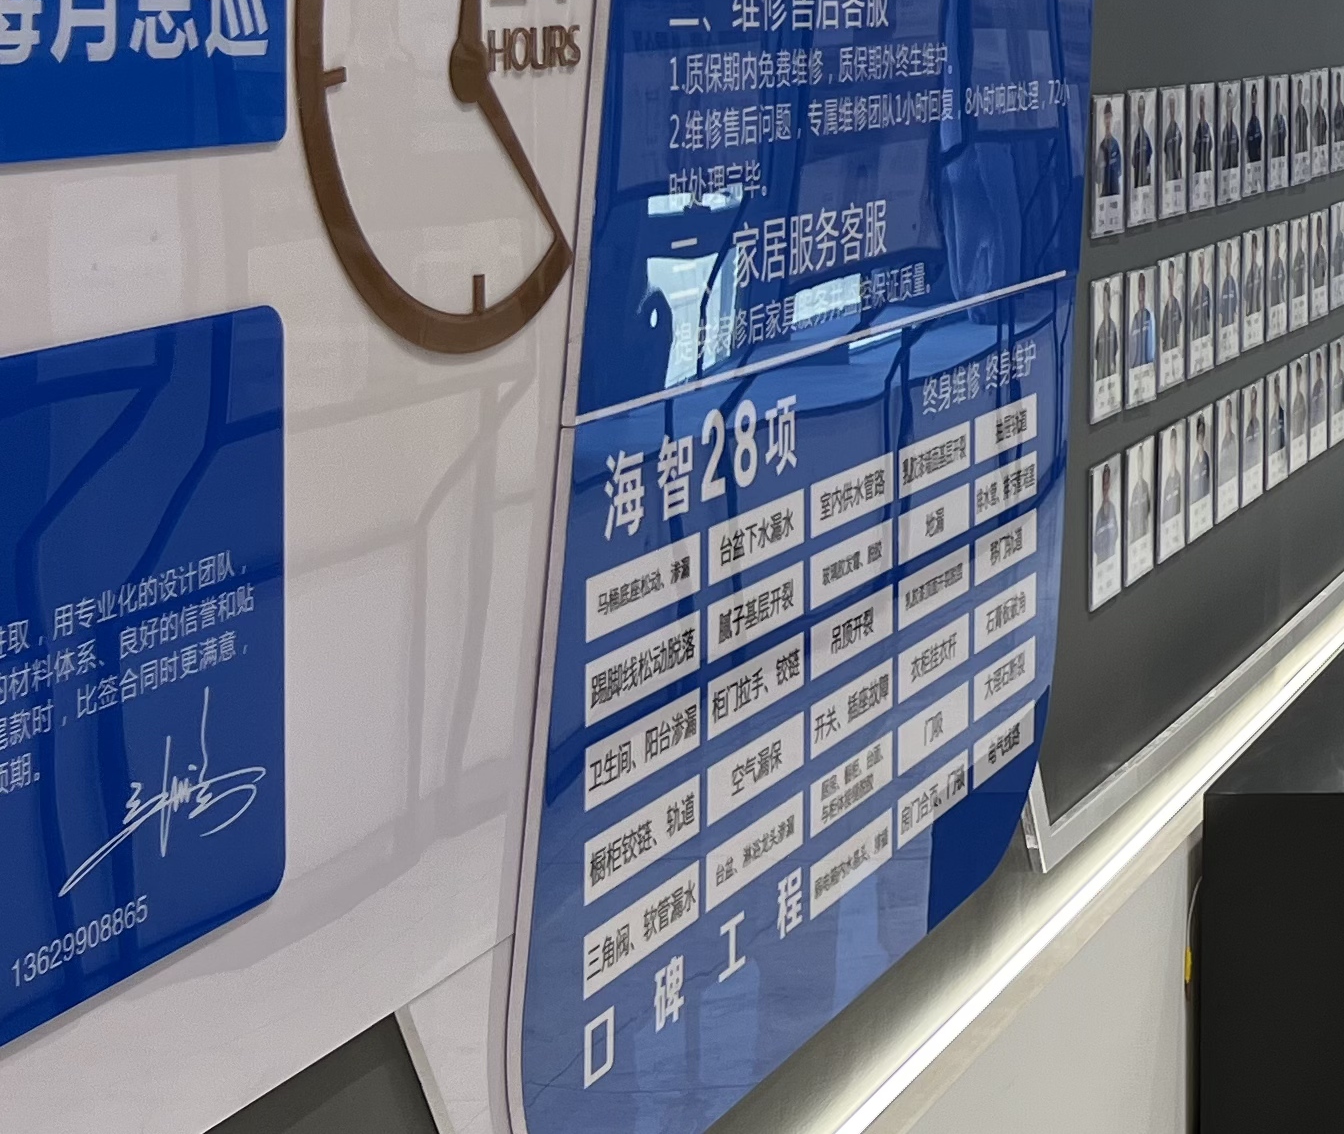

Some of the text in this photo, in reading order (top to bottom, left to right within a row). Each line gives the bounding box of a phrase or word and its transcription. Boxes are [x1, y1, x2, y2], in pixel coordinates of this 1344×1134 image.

[487, 24, 580, 72] HOURS
[670, 43, 953, 94] 1.质保期内免费维修，质保期外终生维护。
[669, 160, 768, 209] 时处理完毕。
[922, 360, 981, 416] 终身维修
[603, 395, 798, 541] 海智28项
[819, 469, 886, 521] 室内供水管路
[719, 508, 795, 566] 台盆下水漏水
[924, 507, 946, 538] 地漏
[717, 578, 795, 643] 腻子基层开裂
[830, 608, 875, 654] 吊顶开裂
[590, 629, 696, 709] 踢脚线松动脱落
[712, 648, 800, 722] 柜门拉手、铰链
[814, 674, 889, 746] 开关、插座故障
[588, 704, 698, 793] 卫生间、阳台渗漏
[588, 792, 696, 888] 橱柜铰链、轨道
[11, 894, 149, 990] 13629908865
[587, 880, 697, 980] 三角阀、软管漏水
[584, 868, 803, 1089] 口碑工程
